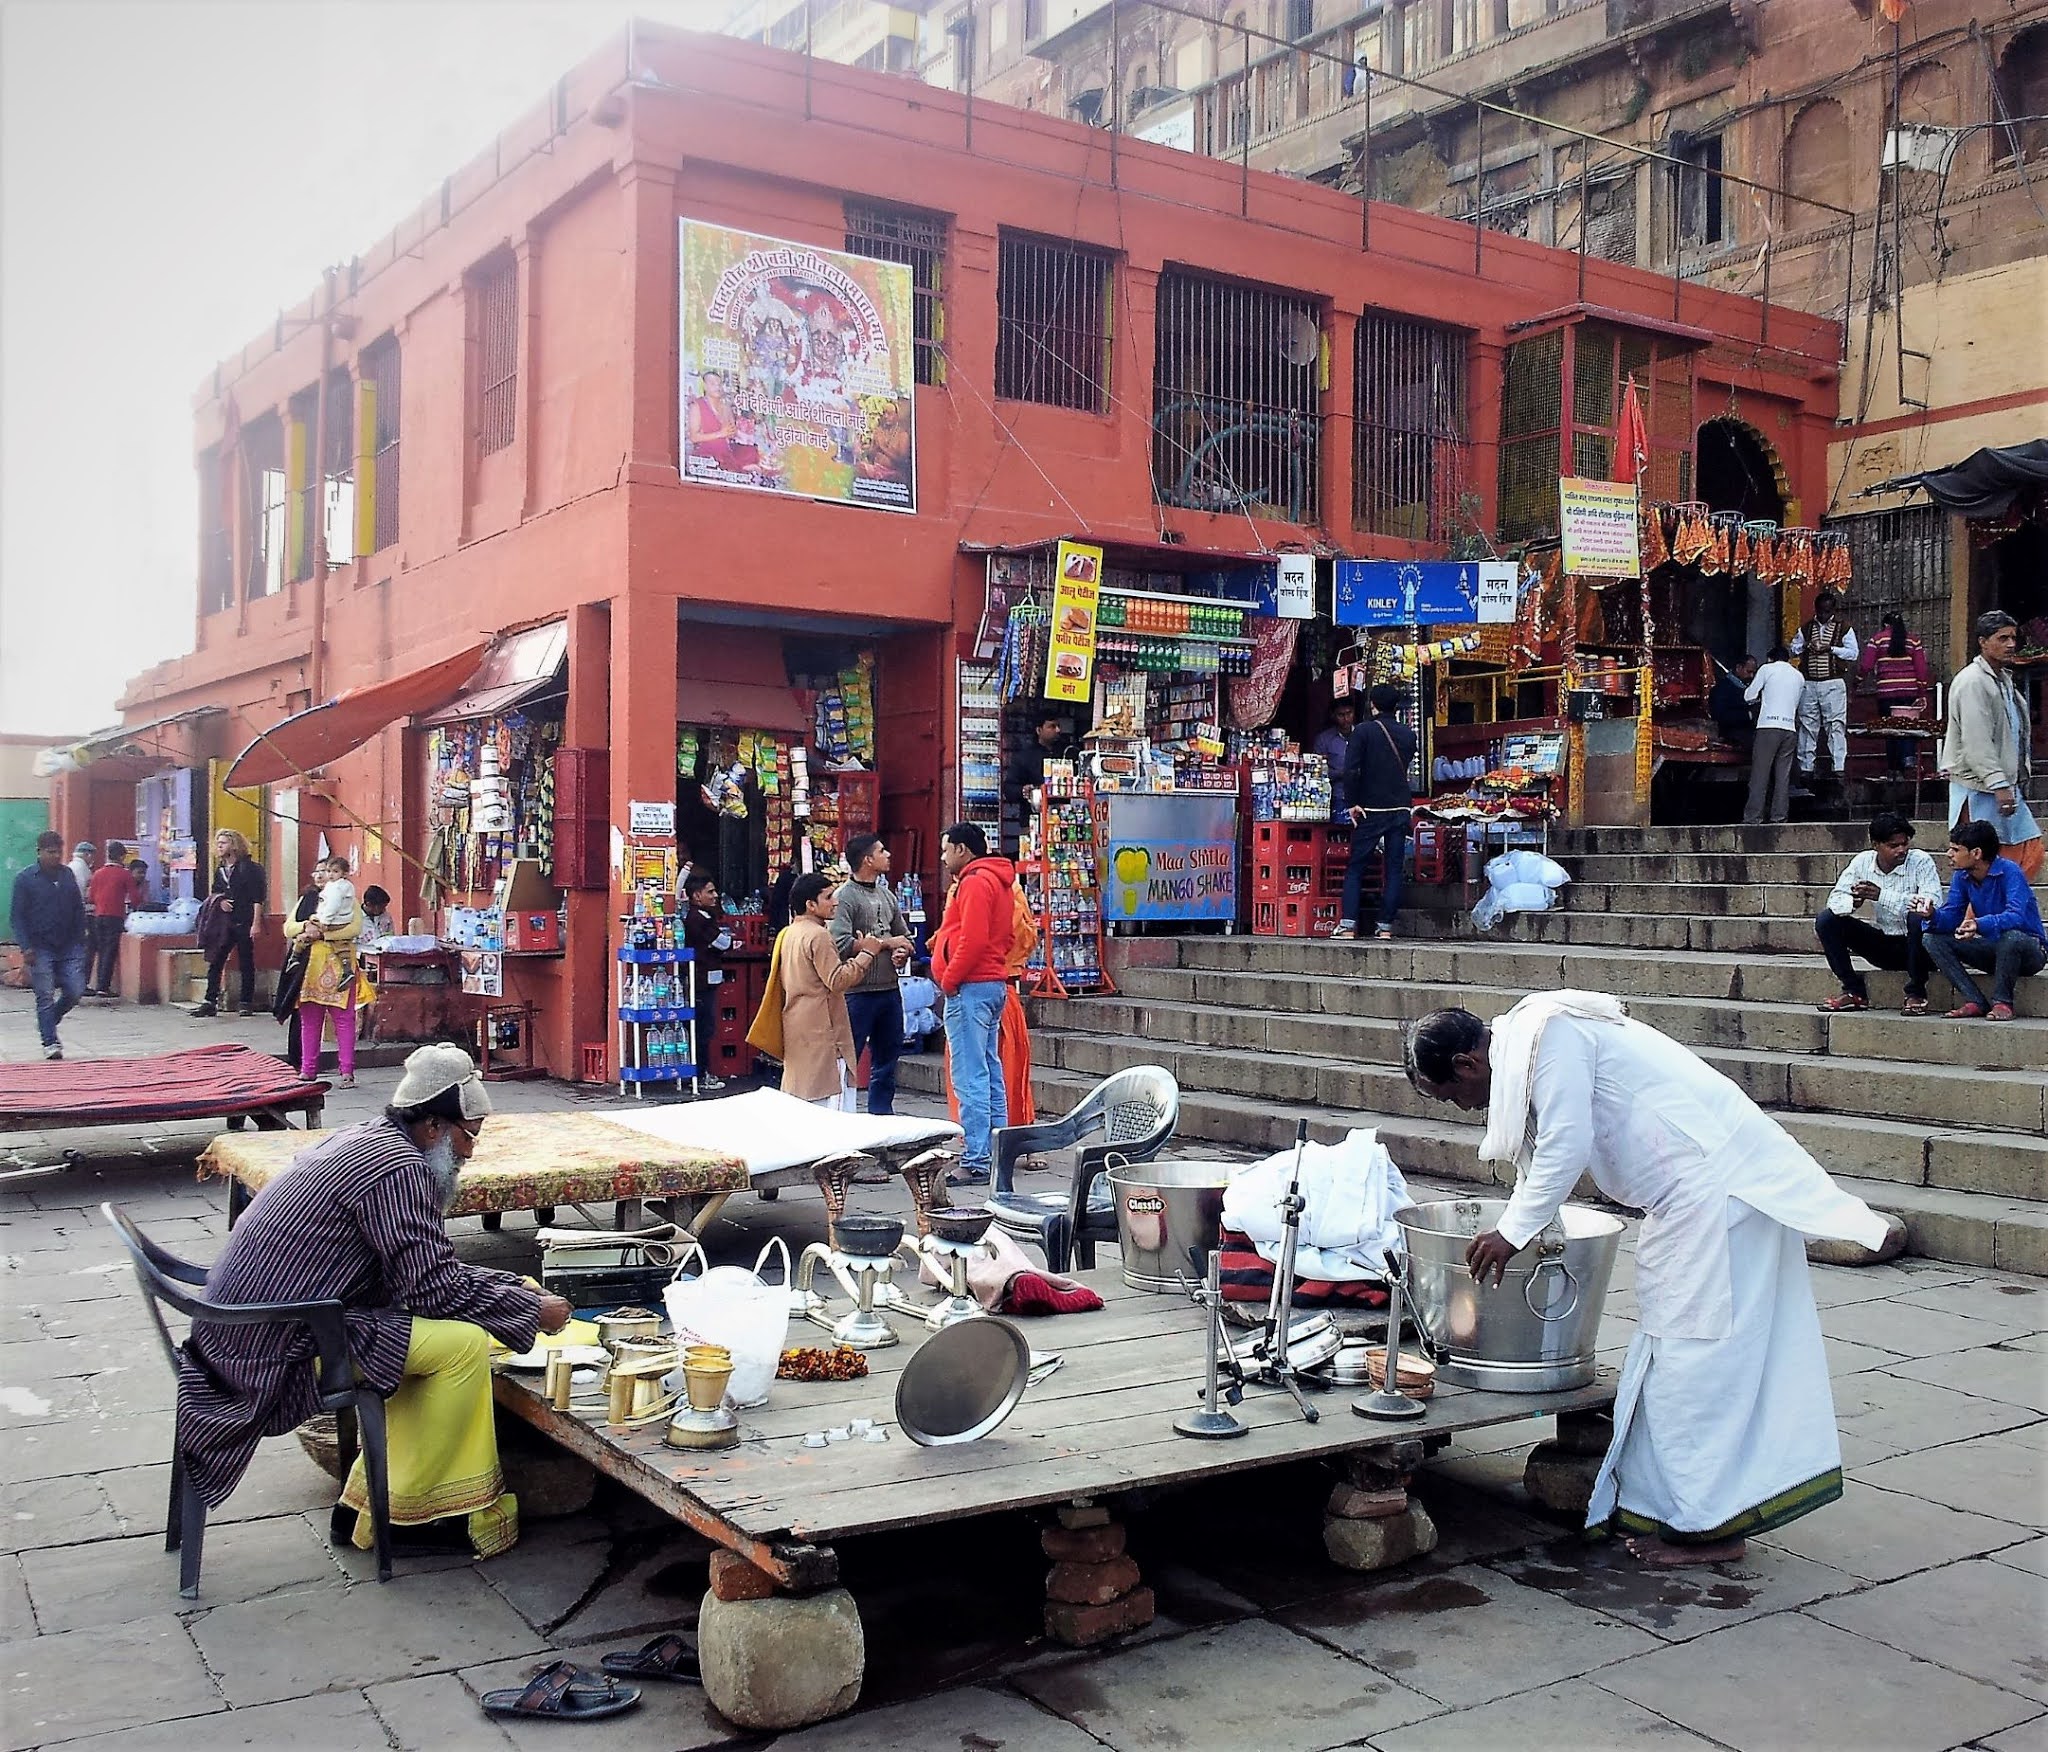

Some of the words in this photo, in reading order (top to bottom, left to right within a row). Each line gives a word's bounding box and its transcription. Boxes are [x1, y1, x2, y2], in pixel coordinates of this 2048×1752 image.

[1283, 571, 1305, 586] मदन
[1485, 578, 1509, 592] मदन
[1060, 584, 1076, 600] आलू
[1367, 598, 1398, 610] KINLEY
[1155, 851, 1185, 872] Maa
[1189, 848, 1230, 870] Shitla
[1147, 877, 1194, 902] MANGO
[1196, 871, 1234, 897] SHAKE
[1128, 1198, 1163, 1211] Classic
